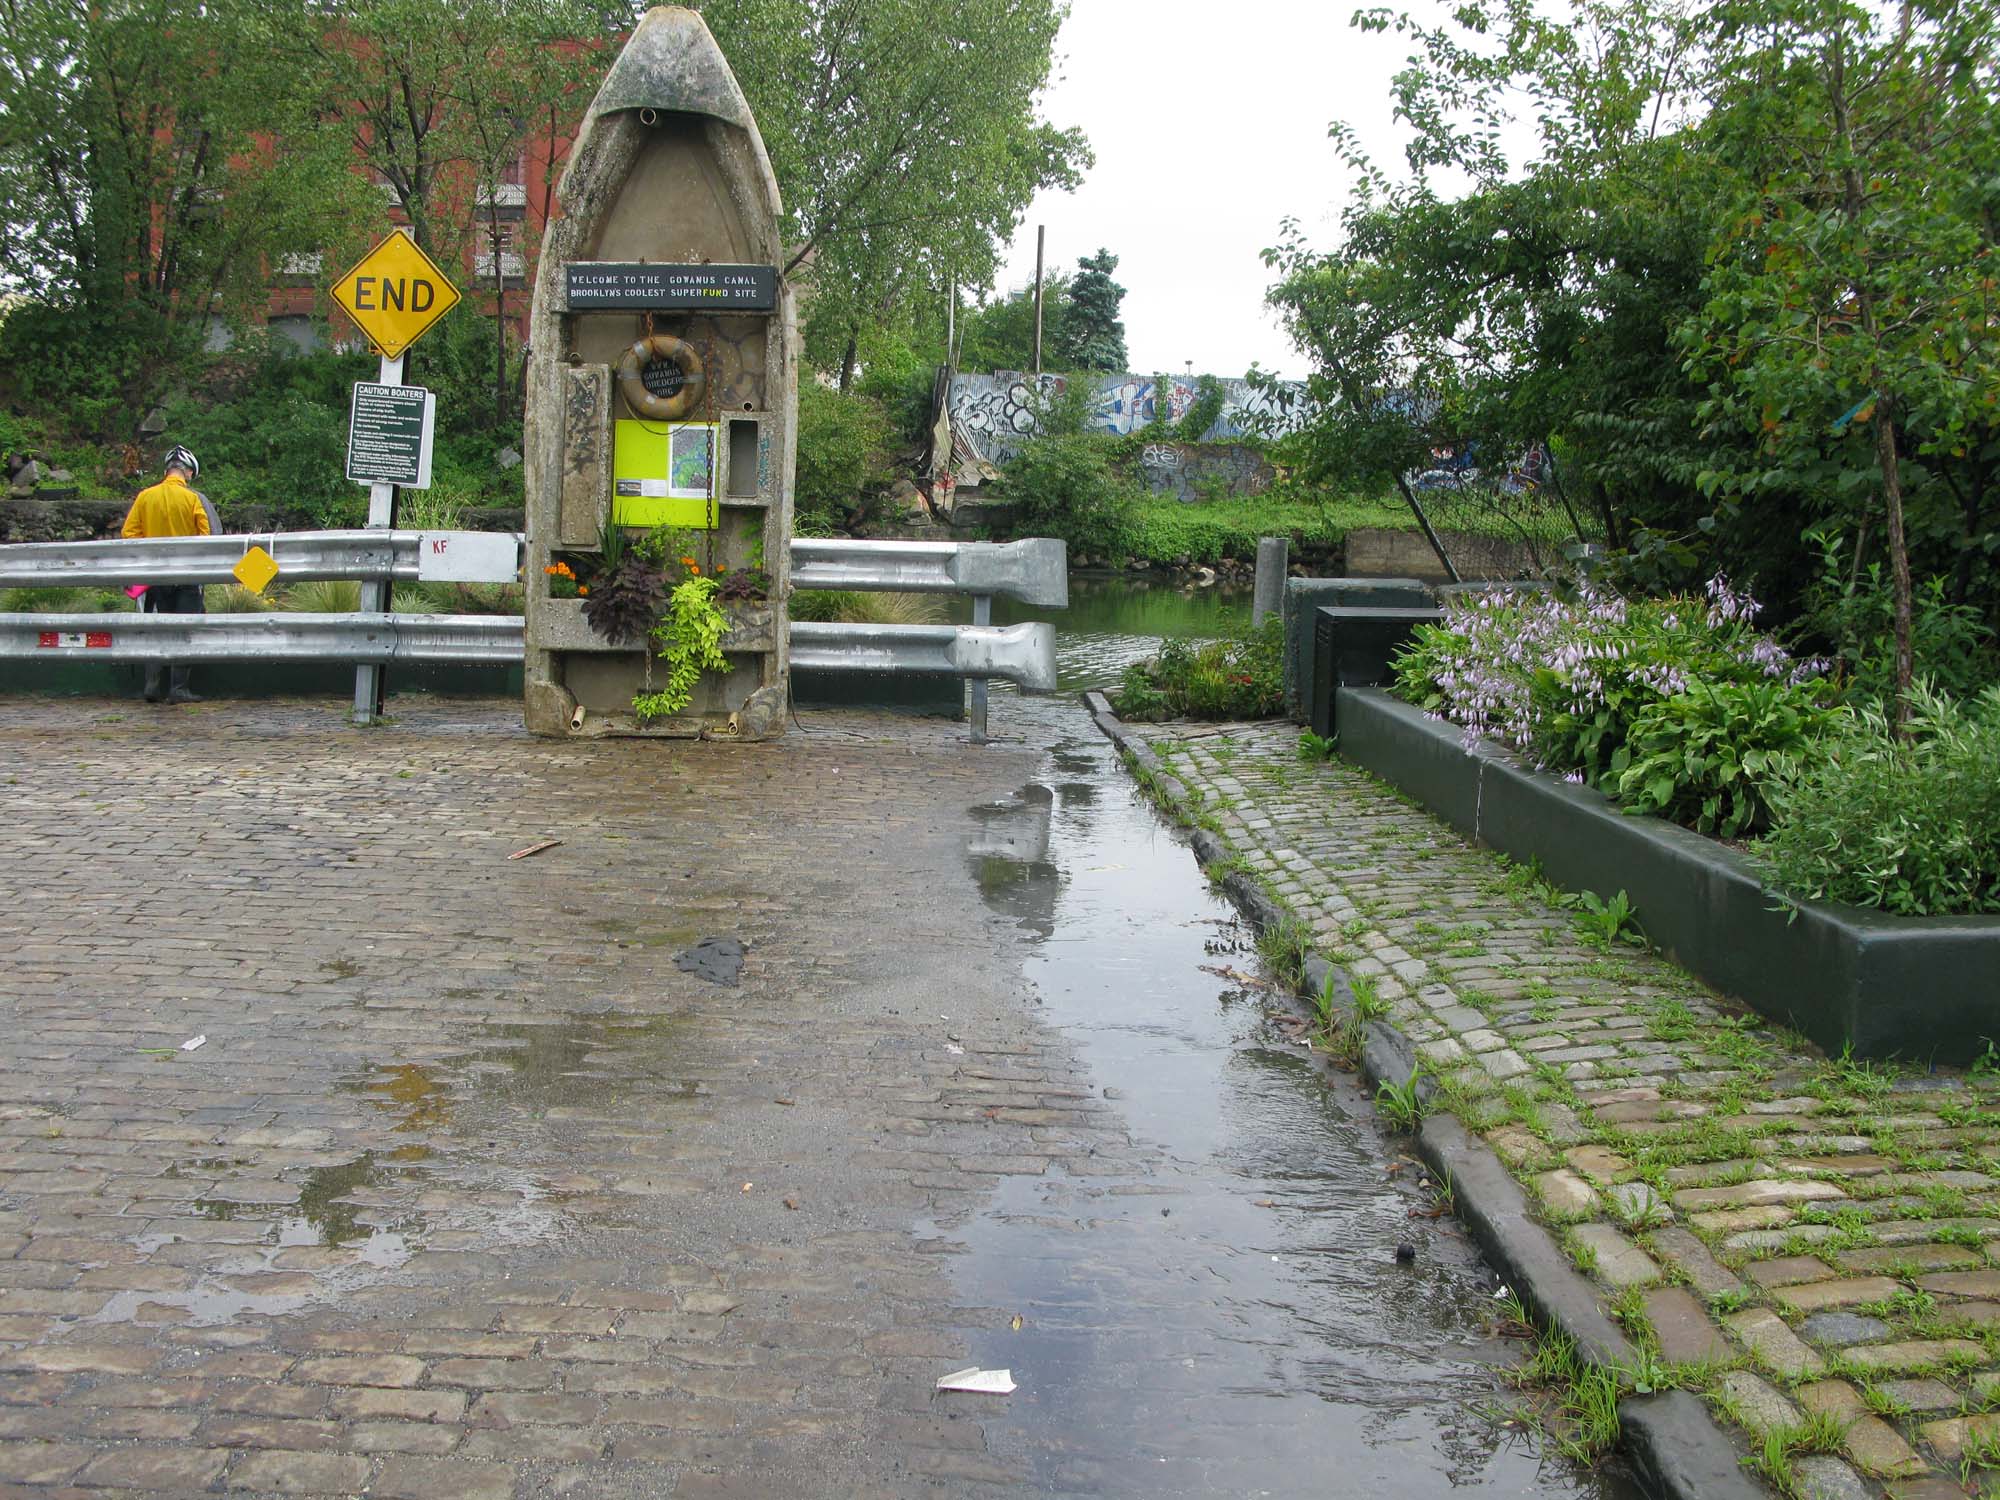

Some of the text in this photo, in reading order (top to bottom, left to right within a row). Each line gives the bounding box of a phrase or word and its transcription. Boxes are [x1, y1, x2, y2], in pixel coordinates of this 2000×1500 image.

[571, 275, 757, 286] WELCOME TO THE GOWANUS CANAL
[355, 276, 434, 313] END
[570, 288, 757, 298] BROOKLYN'S COOLEST SUPERFUND SITE
[359, 386, 424, 399] CAUTION BOATERS
[432, 540, 448, 554] KF
